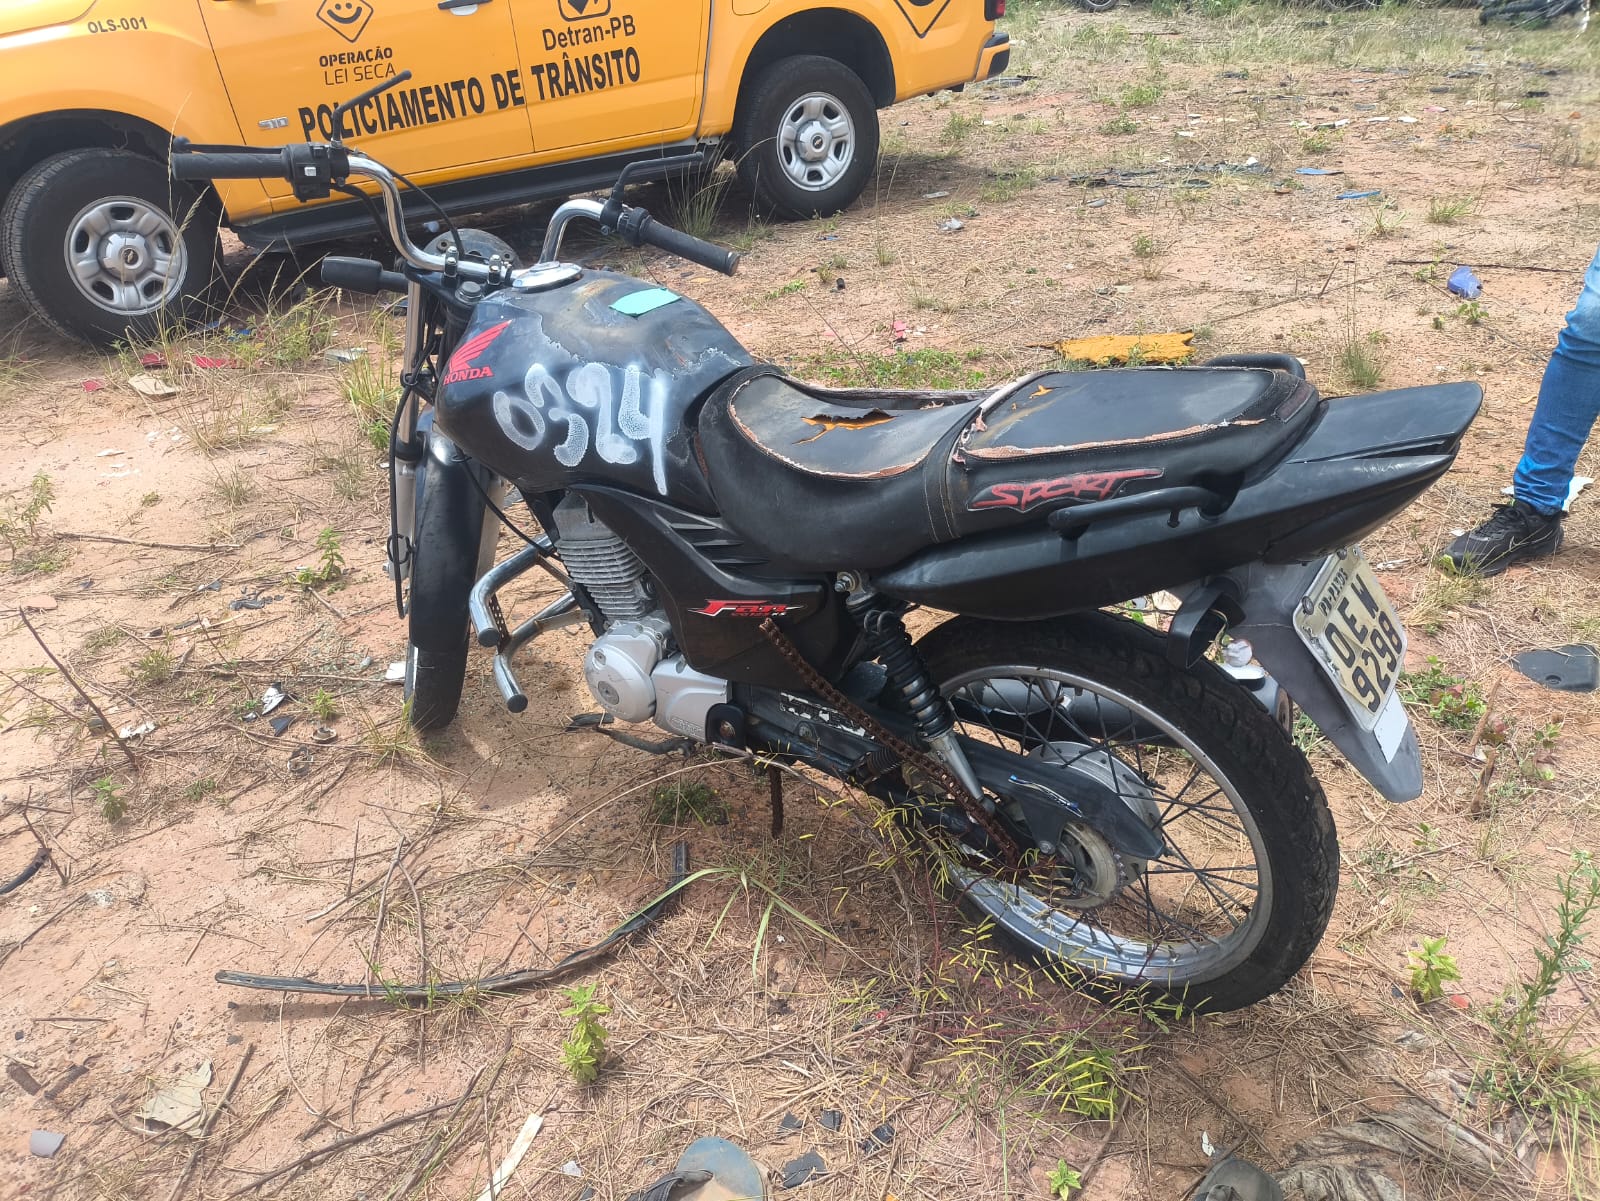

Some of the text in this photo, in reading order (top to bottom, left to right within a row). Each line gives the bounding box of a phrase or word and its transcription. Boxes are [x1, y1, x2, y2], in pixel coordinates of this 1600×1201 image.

[87, 16, 148, 34] OLS-001
[541, 14, 636, 51] Detran-PB
[319, 46, 393, 67] OPERAÇÃO
[324, 62, 396, 86] LEI SECA
[492, 69, 525, 110] DE
[530, 46, 641, 101] TRÂNSITO
[443, 365, 494, 386] HONDA
[971, 467, 1164, 511] SPORT
[1324, 573, 1379, 669] OEW
[1351, 610, 1403, 713] 9298
